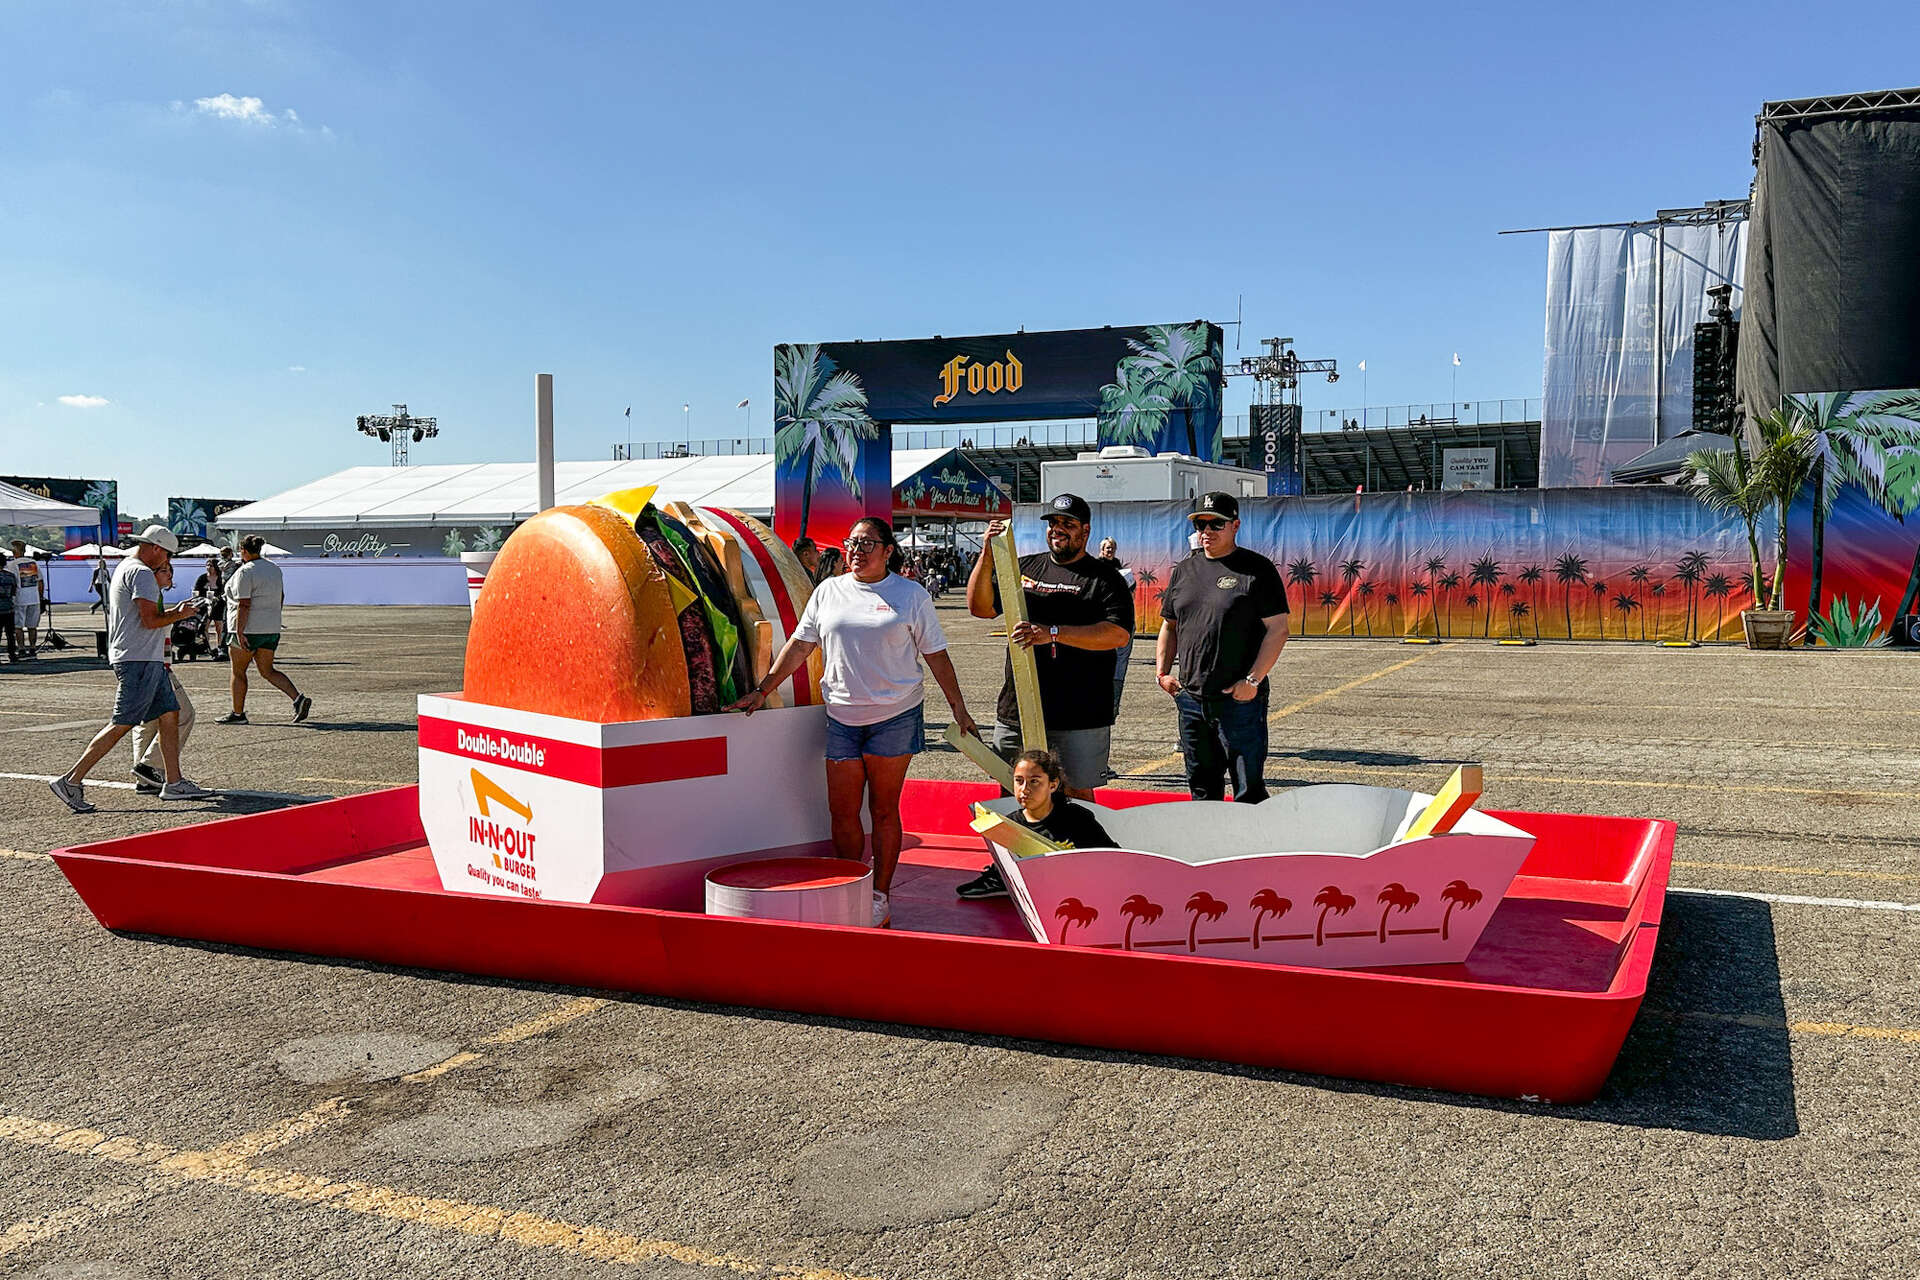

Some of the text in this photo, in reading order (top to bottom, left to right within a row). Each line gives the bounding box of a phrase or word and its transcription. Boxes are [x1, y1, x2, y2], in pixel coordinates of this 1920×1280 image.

[933, 349, 1023, 408] Food
[1265, 431, 1276, 472] FOOD
[930, 486, 947, 509] You
[948, 487, 963, 504] Can
[1204, 495, 1214, 508] LA
[323, 533, 388, 558] Quality
[469, 816, 536, 861] IN-N-OUT
[467, 863, 491, 884] Quality
[492, 875, 504, 887] you
[506, 880, 519, 893] can
[504, 857, 537, 881] BURGER
